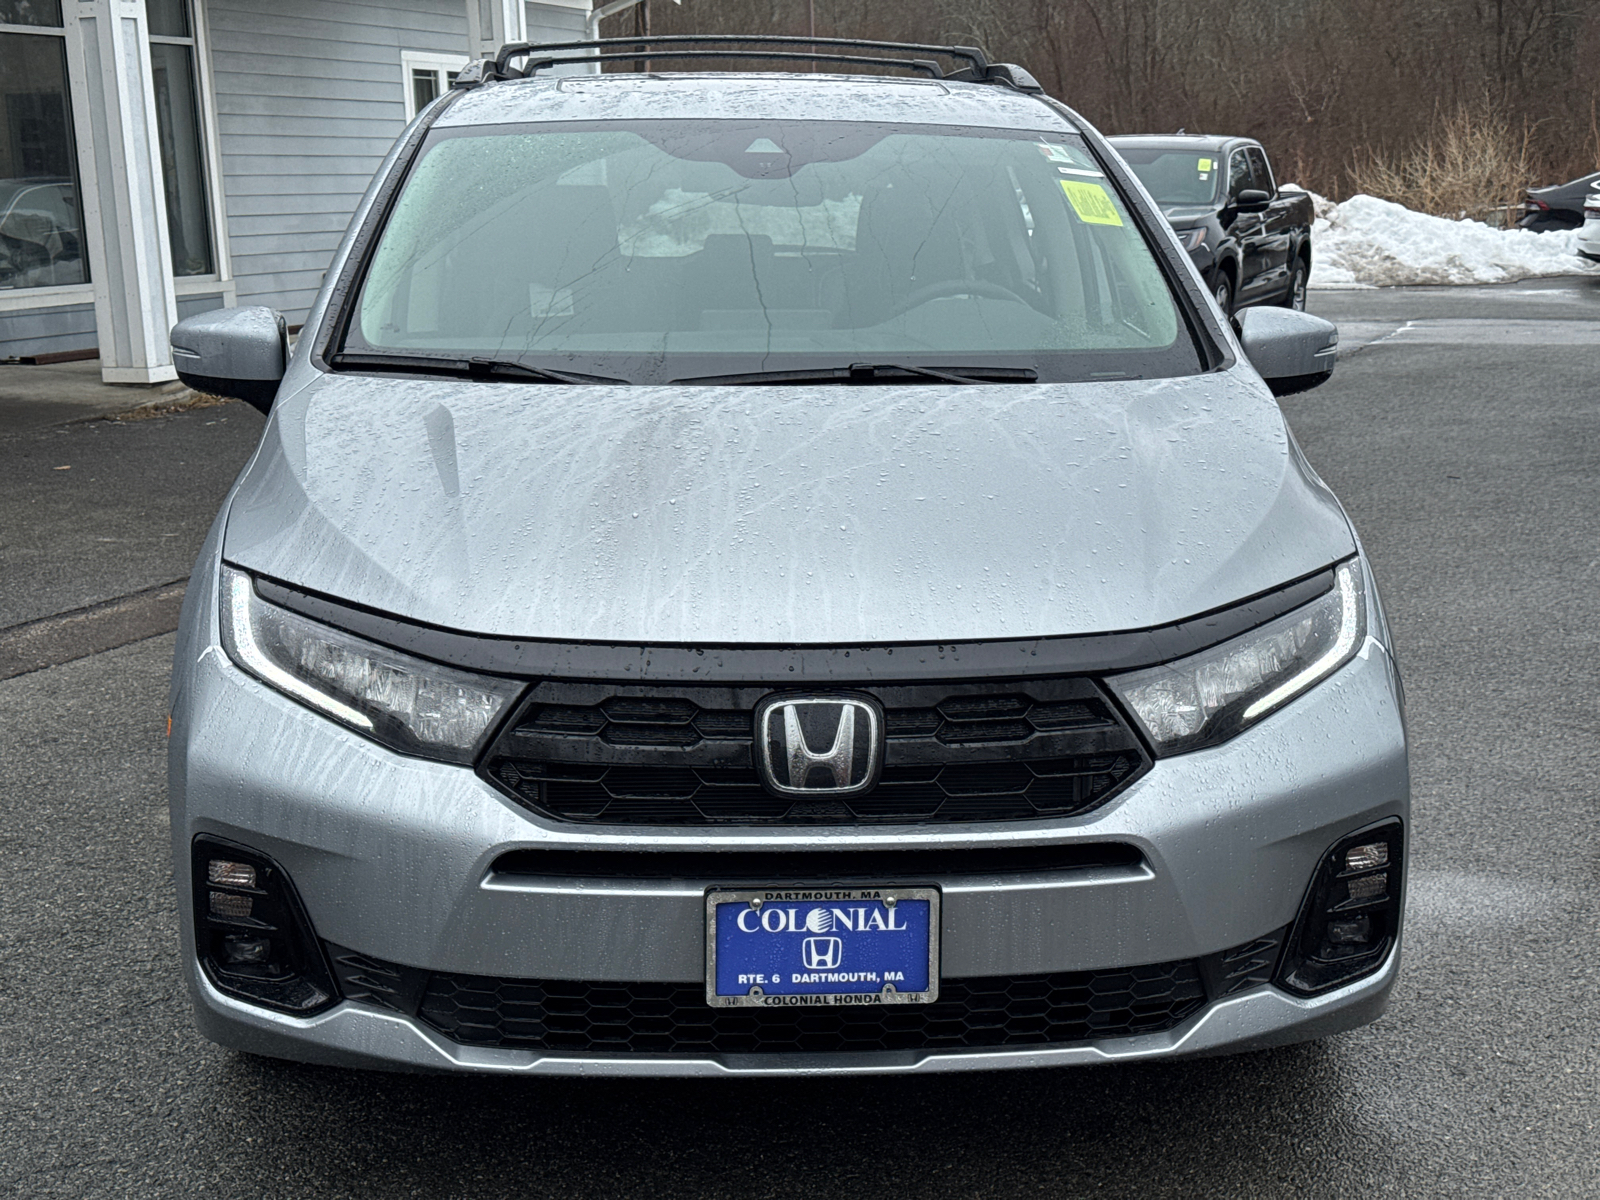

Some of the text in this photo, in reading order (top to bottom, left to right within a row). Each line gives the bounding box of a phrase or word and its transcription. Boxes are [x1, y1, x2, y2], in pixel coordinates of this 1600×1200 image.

[860, 891, 881, 899] MA
[737, 907, 907, 933] COLONIAL
[738, 972, 905, 984] RTE. 6 DARTMOUTH, MA
[764, 994, 882, 1006] COLONIAL HONDA
